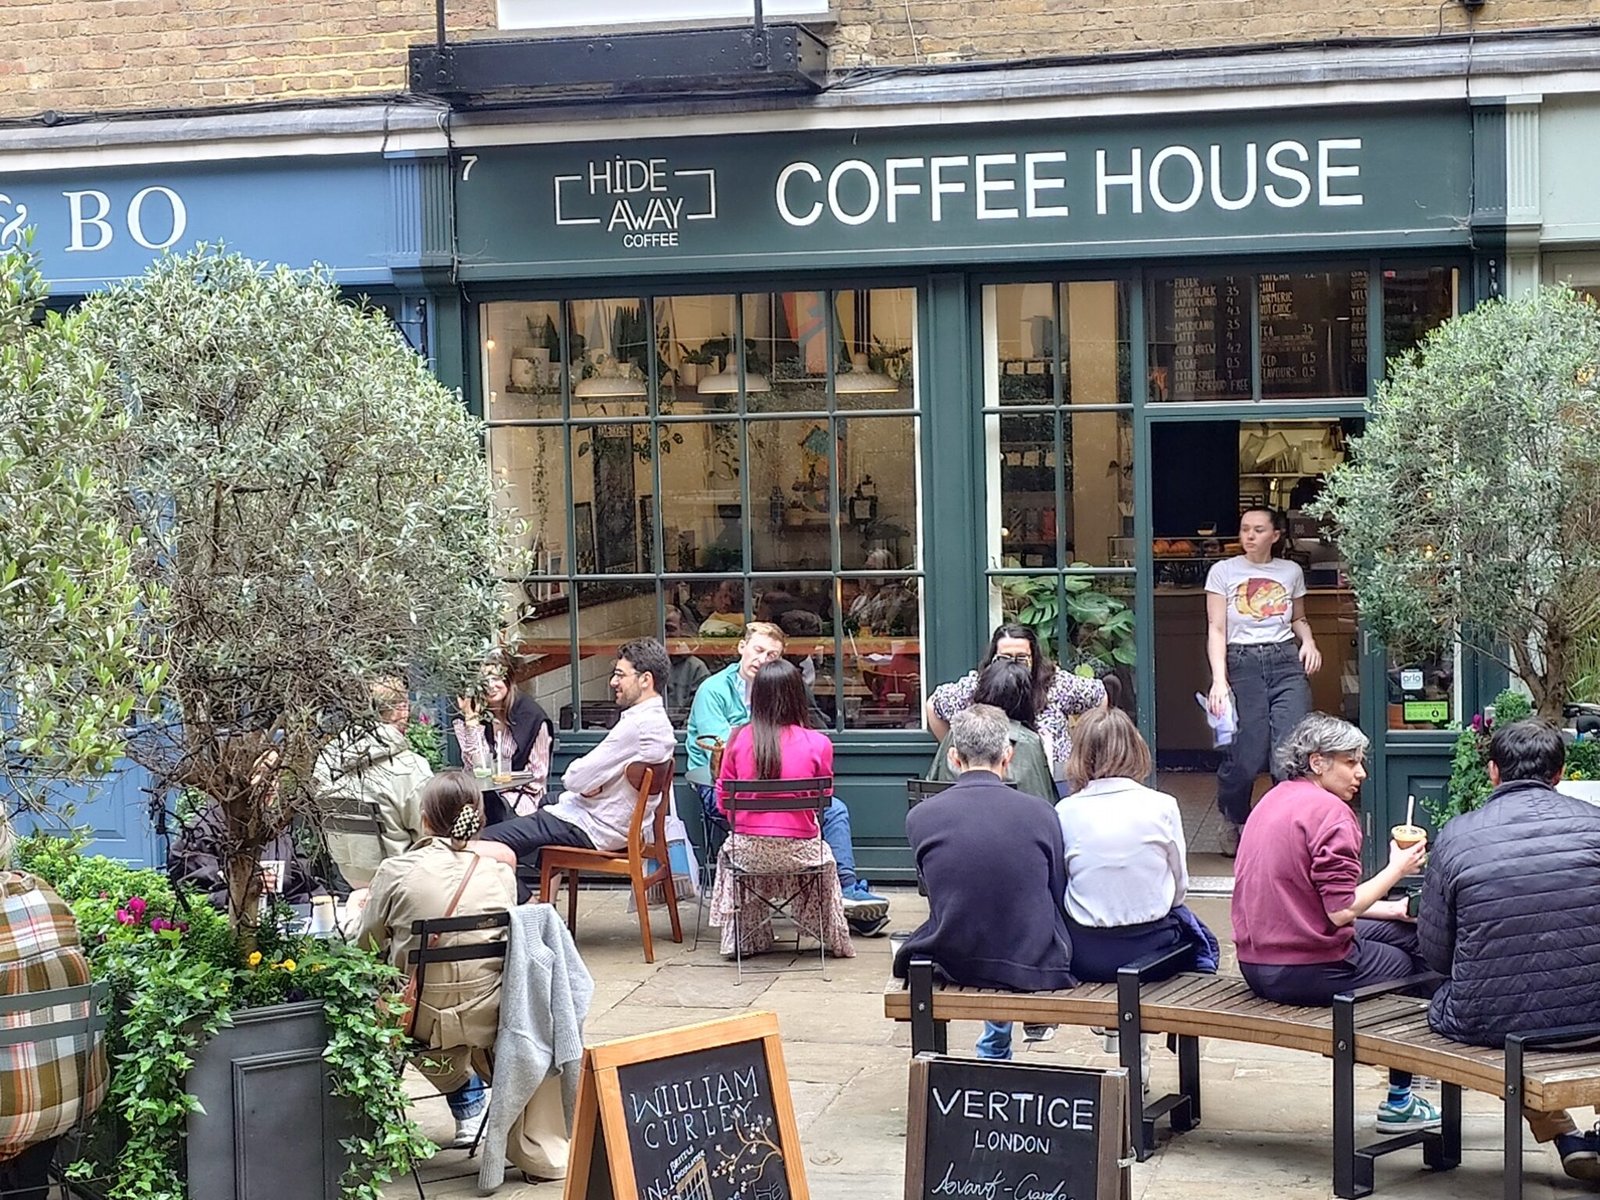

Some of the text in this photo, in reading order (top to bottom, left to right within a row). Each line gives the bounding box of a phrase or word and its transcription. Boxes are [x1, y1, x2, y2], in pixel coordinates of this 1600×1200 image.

[461, 155, 478, 181] 7
[775, 138, 1363, 226] COFFEE HOUSE
[62, 186, 188, 252] BO
[607, 197, 684, 232] AWAY
[623, 232, 679, 248] COFFEE
[1260, 281, 1276, 292] HAI
[1260, 291, 1293, 303] URMERIC
[1260, 353, 1277, 367] CED
[630, 1066, 760, 1123] WILLIAM
[932, 1088, 1094, 1131] VERTICE
[644, 1101, 752, 1149] CURLEY
[974, 1130, 1050, 1155] LONDON
